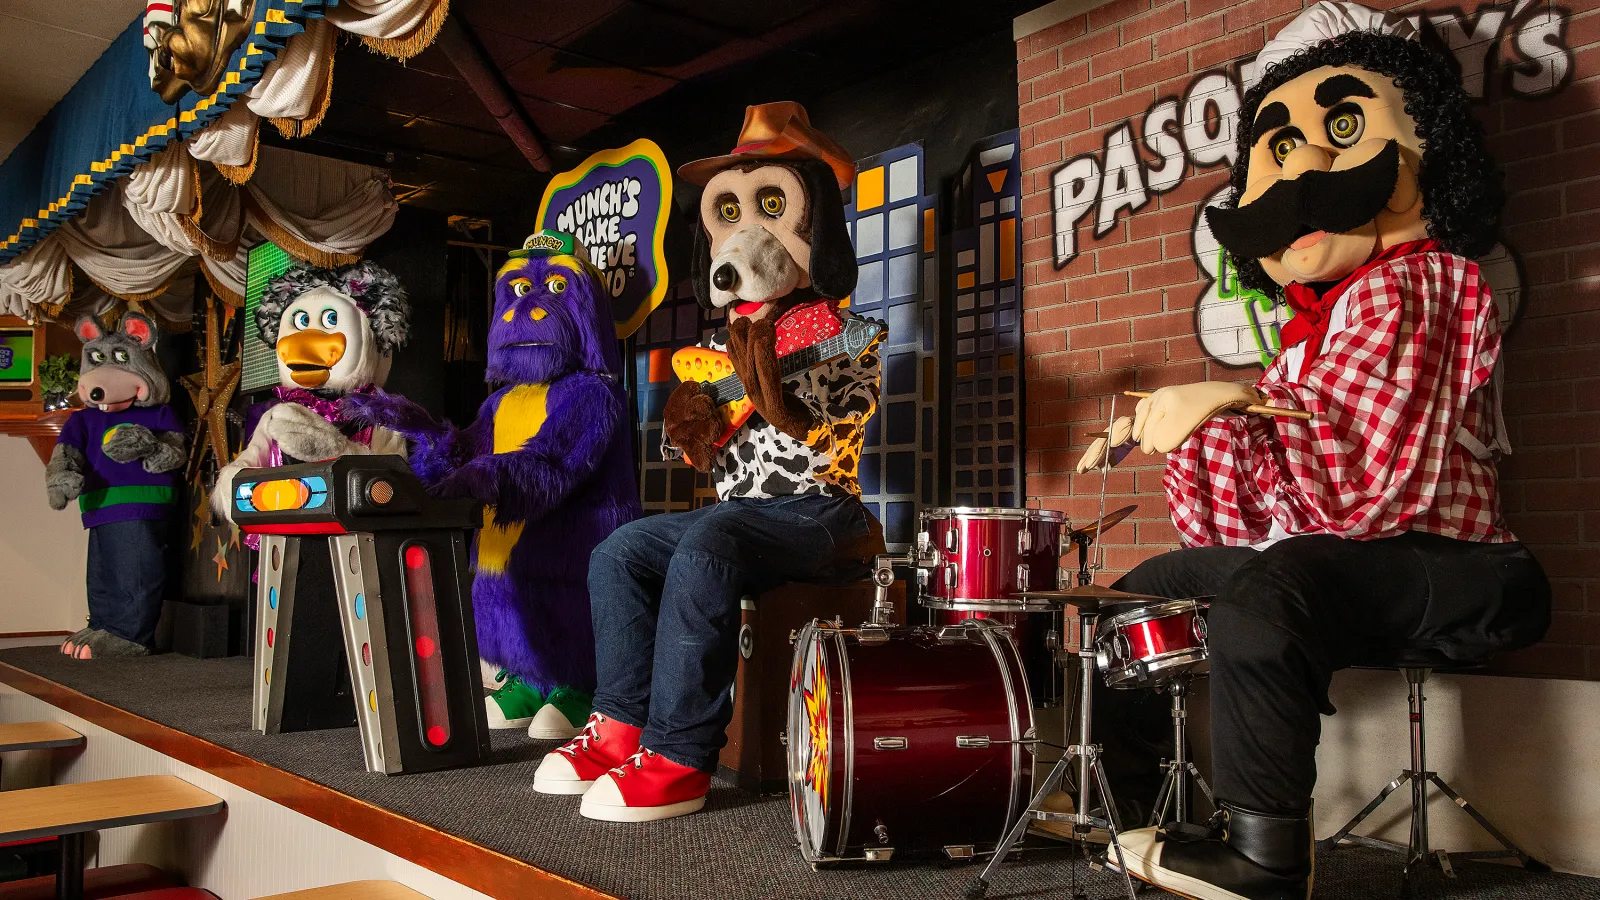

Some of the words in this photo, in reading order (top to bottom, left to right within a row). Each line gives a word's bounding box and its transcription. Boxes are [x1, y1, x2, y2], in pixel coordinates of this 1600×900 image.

[1052, 0, 1570, 268] PASQY'S
[556, 176, 642, 234] MUNCH'S
[526, 235, 563, 250] MUNCH
